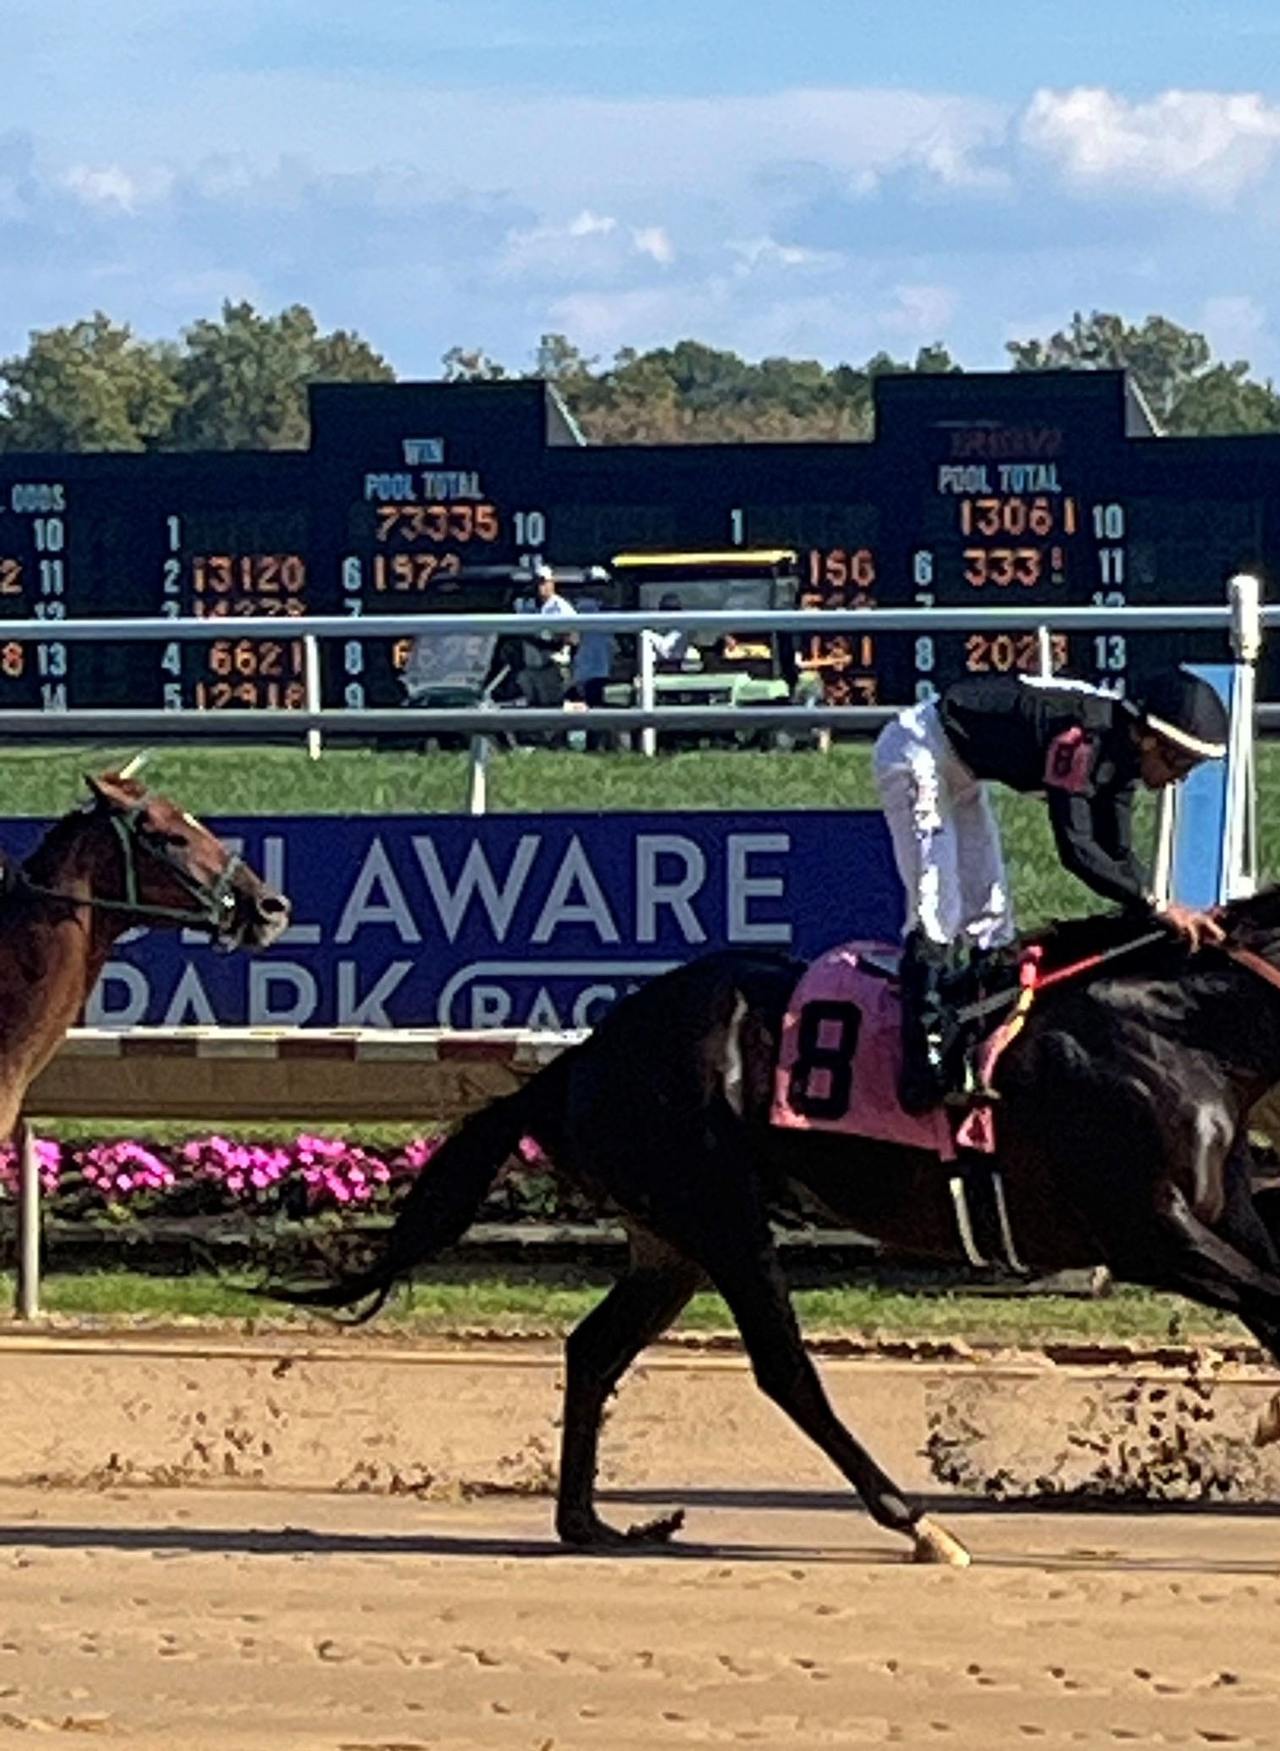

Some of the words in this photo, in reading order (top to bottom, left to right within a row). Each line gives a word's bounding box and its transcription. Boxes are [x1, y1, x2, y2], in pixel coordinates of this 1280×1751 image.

[364, 473, 416, 500] POOL
[422, 471, 485, 500] TOTAL
[937, 464, 992, 494] POOL
[998, 462, 1062, 494] TOTAL
[11, 483, 66, 514] ODDS
[33, 517, 65, 551] 10
[167, 515, 180, 551] 1
[513, 511, 545, 546] 10
[731, 509, 743, 545] 1
[1093, 503, 1125, 539] 10
[38, 559, 65, 595] 11
[163, 558, 181, 594] 2
[342, 556, 362, 591] 6
[913, 550, 933, 586] 6
[1098, 547, 1124, 584] 11
[37, 642, 67, 676] 13
[161, 642, 181, 676] 4
[915, 635, 934, 671] 8
[1094, 635, 1126, 670] 13
[114, 834, 795, 945] LAWARE
[791, 1000, 863, 1119] 8
